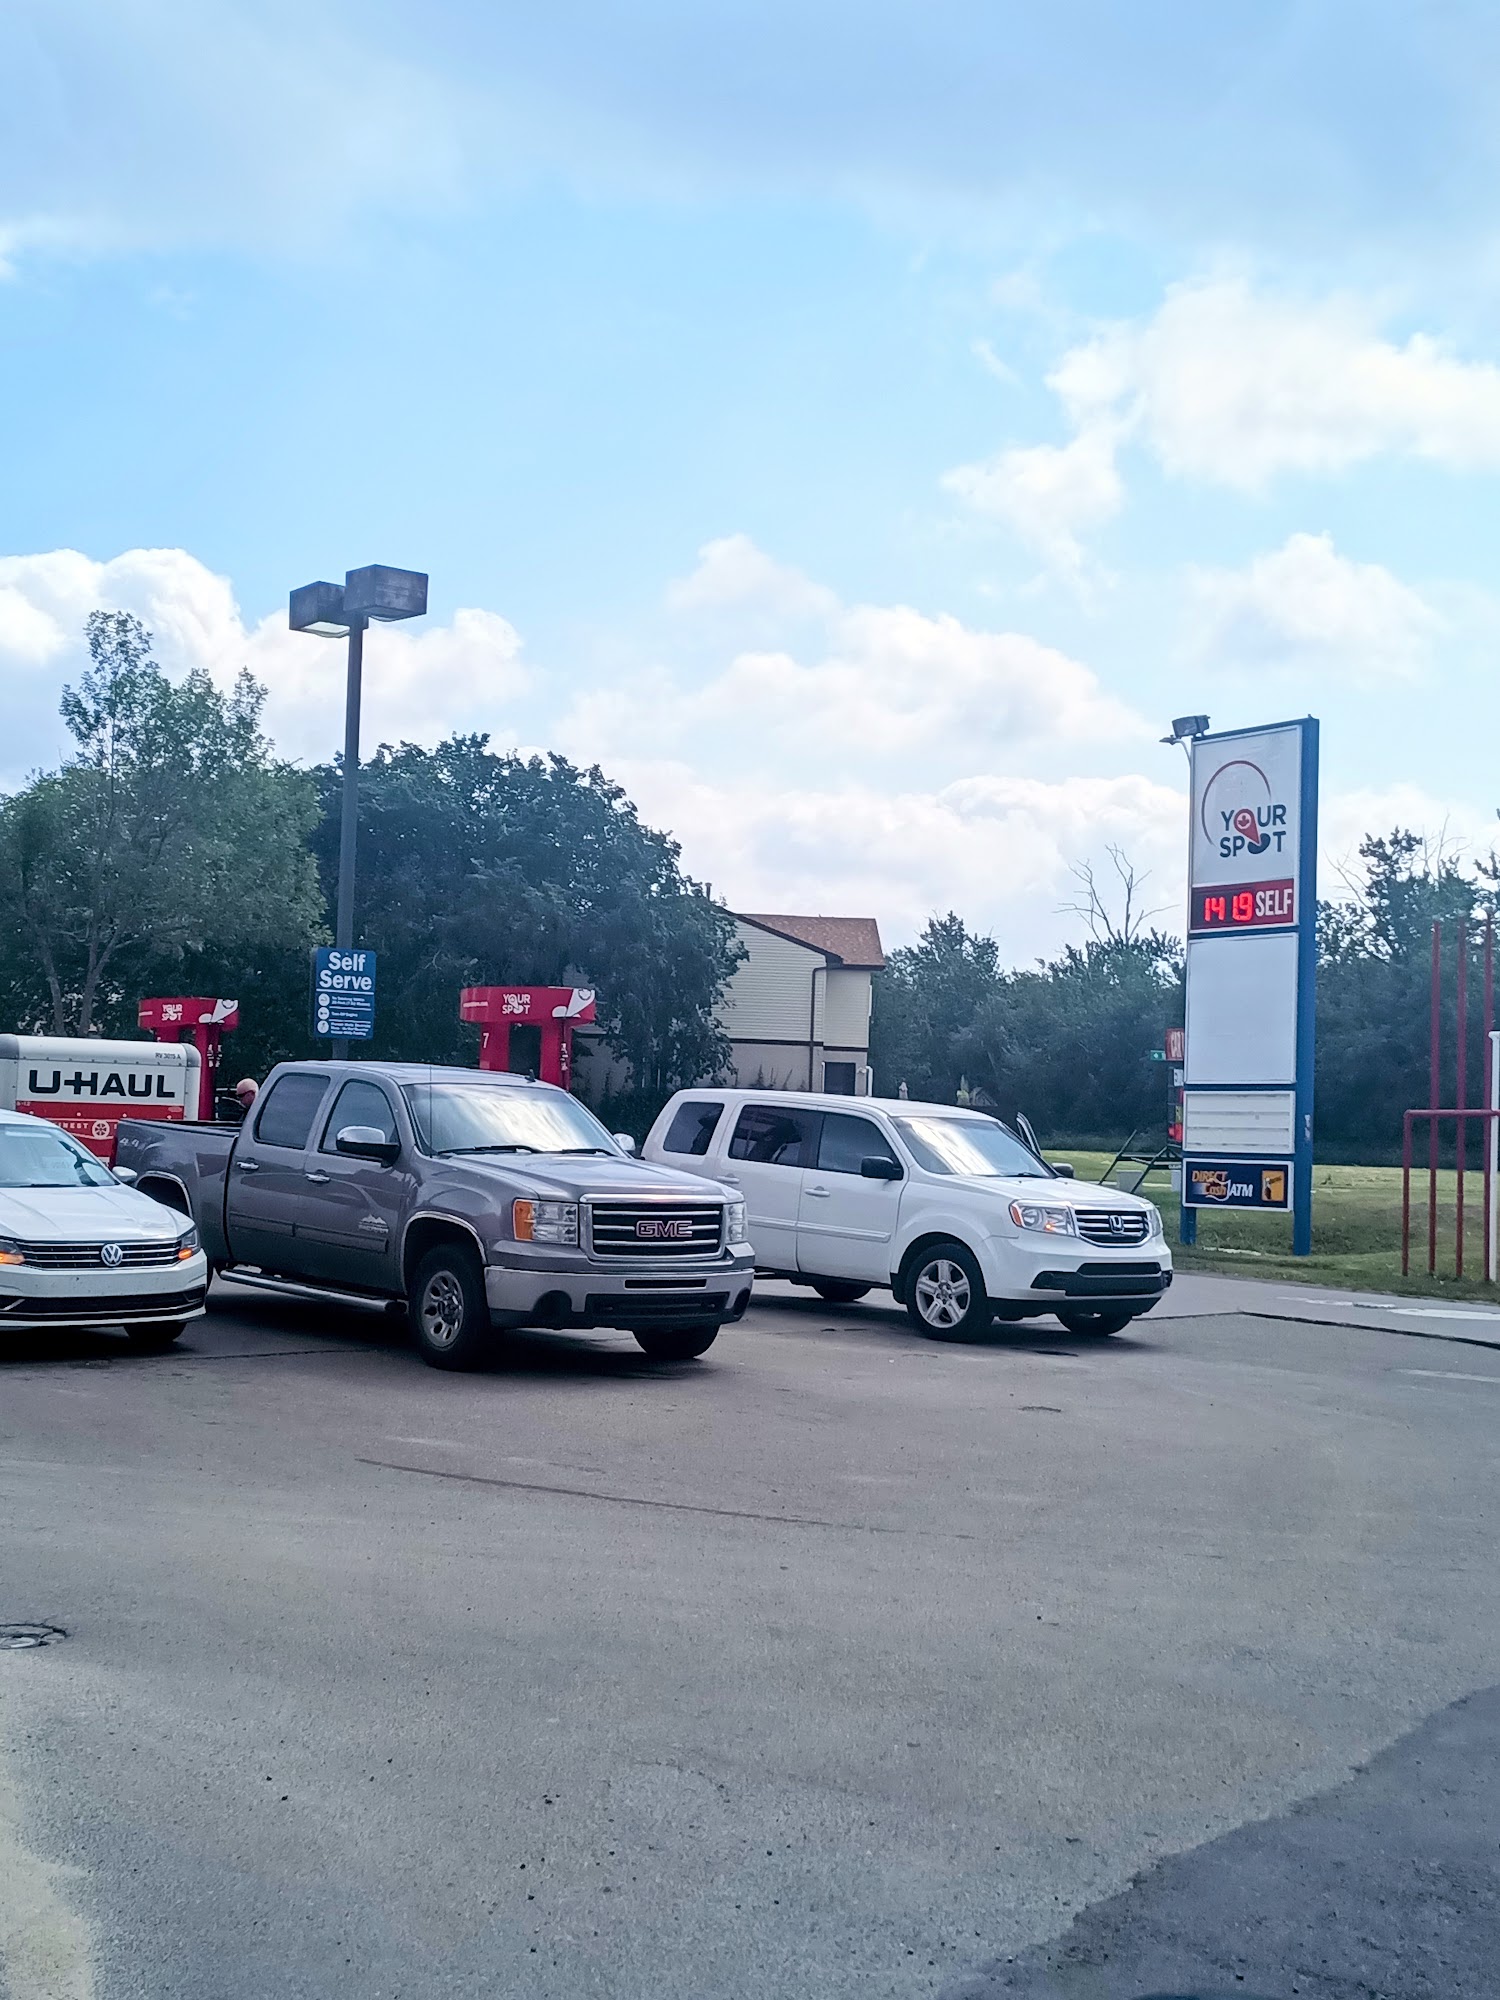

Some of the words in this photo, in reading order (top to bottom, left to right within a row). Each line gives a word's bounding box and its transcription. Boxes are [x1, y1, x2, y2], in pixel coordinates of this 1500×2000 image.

[1220, 804, 1287, 831] YOUR
[1219, 830, 1287, 858] SPOT
[1255, 888, 1293, 917] SELF
[328, 951, 366, 972] Self
[319, 969, 372, 991] Serve
[502, 993, 531, 1004] YOUR
[501, 1004, 531, 1015] SPOT
[483, 1032, 490, 1049] 7
[28, 1069, 176, 1098] U-HAUL
[1191, 1170, 1228, 1182] DIRECT
[1229, 1183, 1254, 1198] ATM
[636, 1220, 693, 1238] GMC
